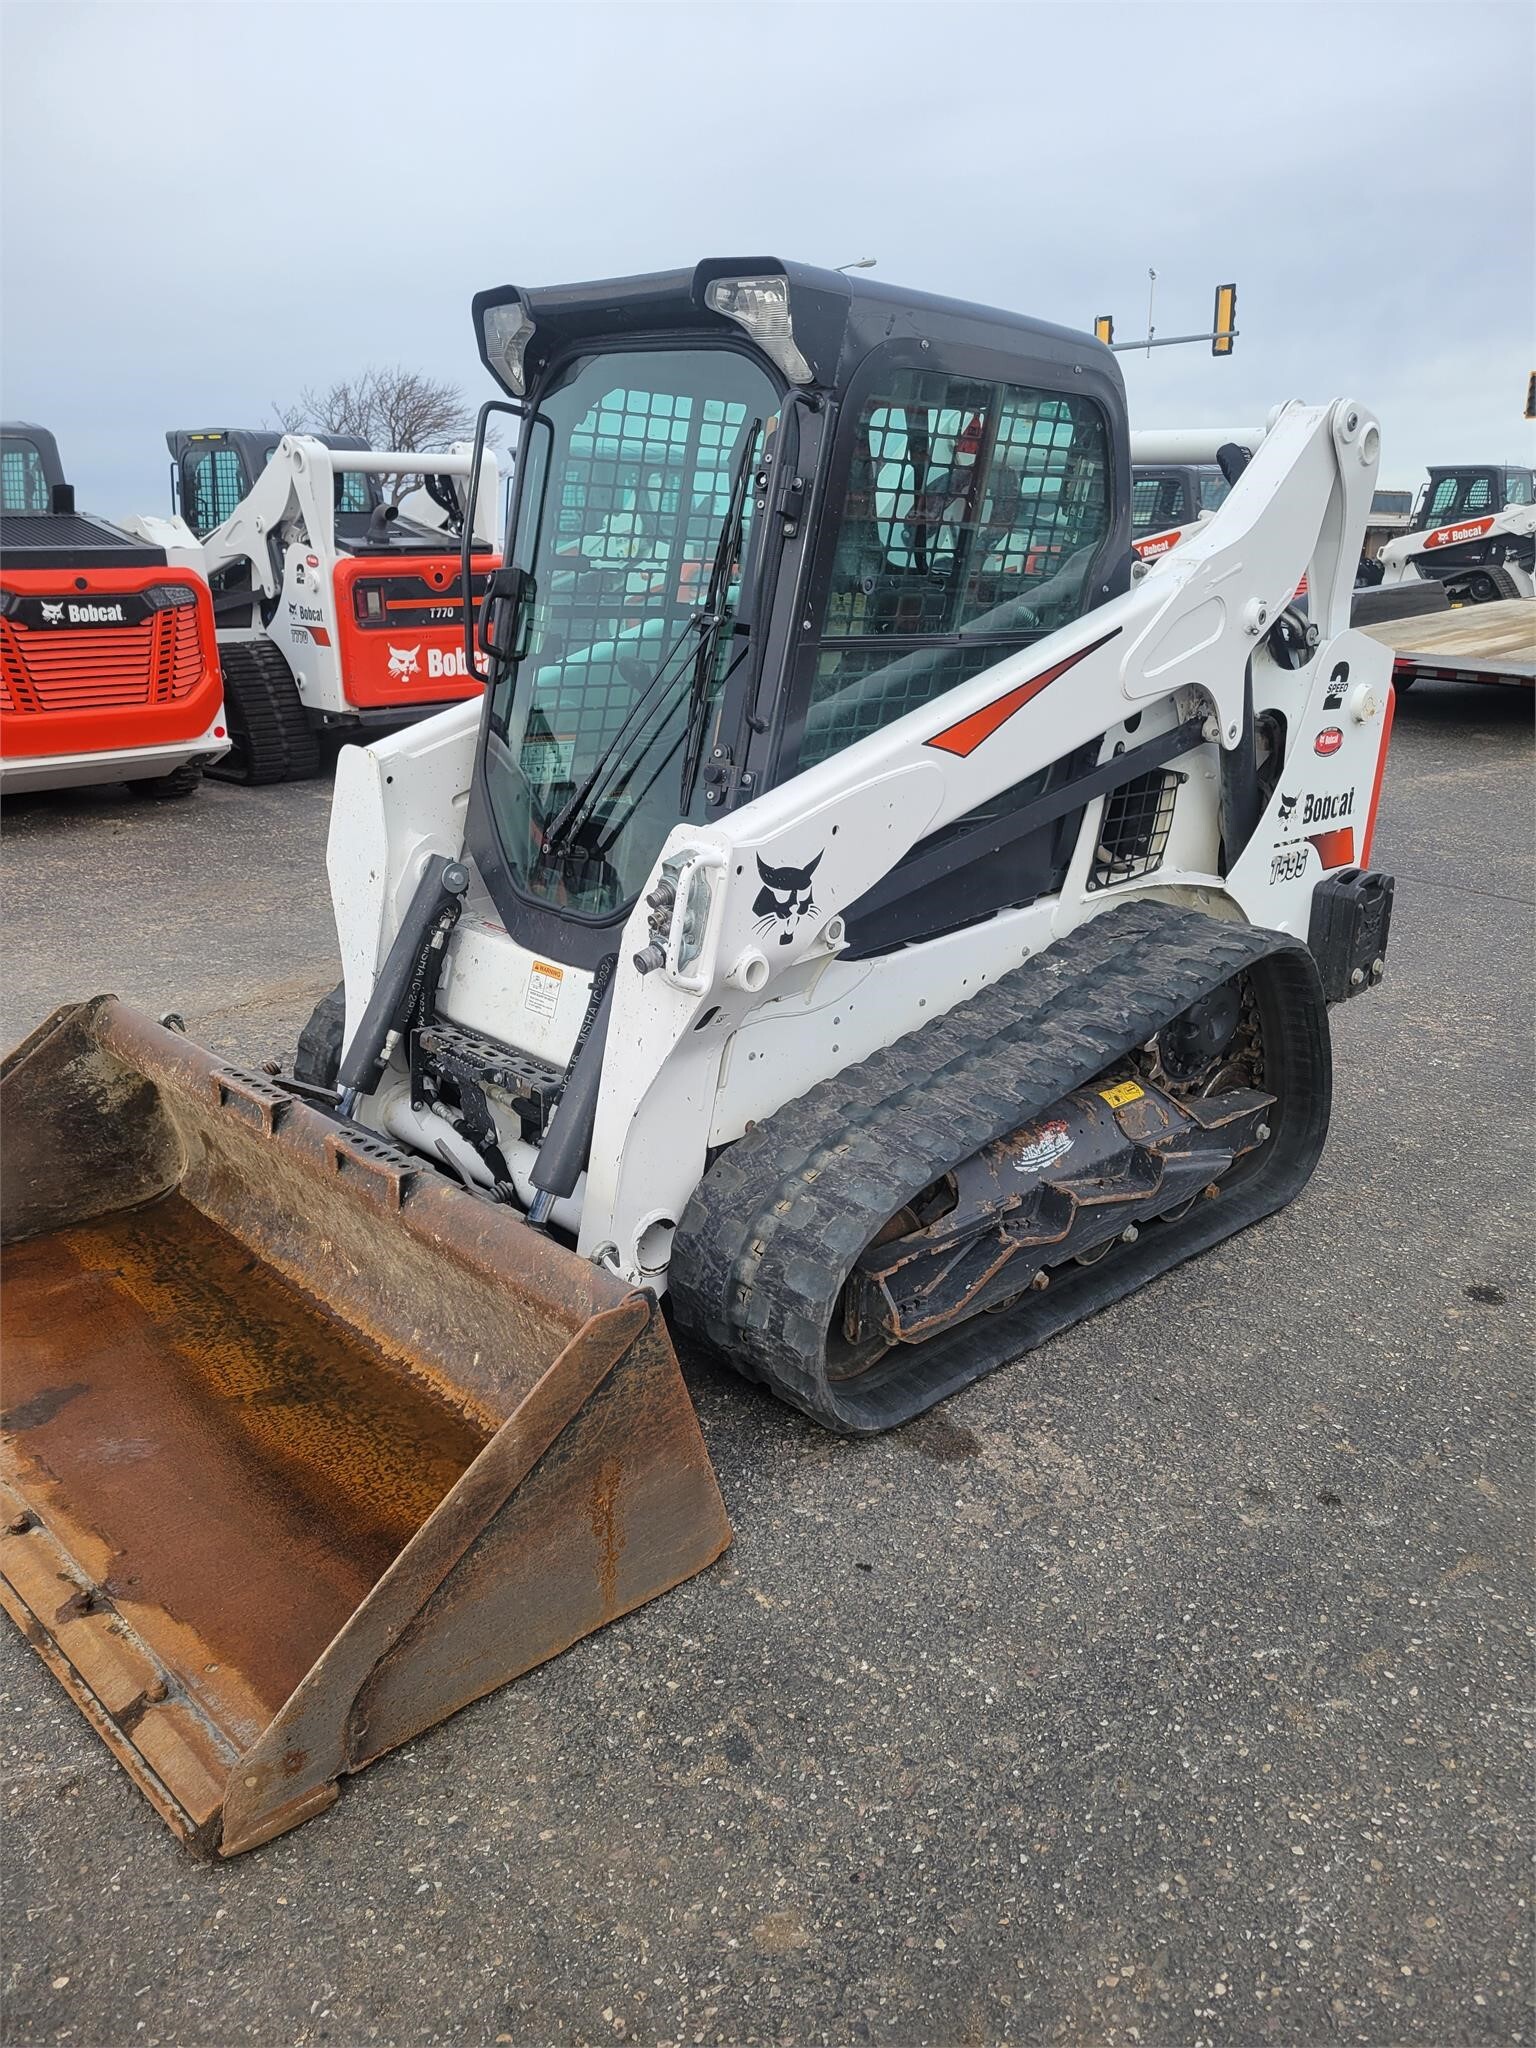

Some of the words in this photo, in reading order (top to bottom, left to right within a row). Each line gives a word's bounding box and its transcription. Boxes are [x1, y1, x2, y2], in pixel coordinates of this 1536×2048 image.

[1452, 526, 1482, 541] Bobcat
[1143, 540, 1169, 556] Bobcat
[68, 604, 124, 622] Bobcat
[299, 605, 324, 622] Bobcat
[430, 607, 454, 618] T770
[291, 630, 309, 645] T770
[427, 647, 489, 678] Bobca
[1327, 683, 1349, 698] SPEED
[1303, 787, 1355, 824] Bobcat
[1270, 848, 1309, 885] T595
[539, 965, 561, 978] WARNING
[578, 1005, 599, 1044] MSHA
